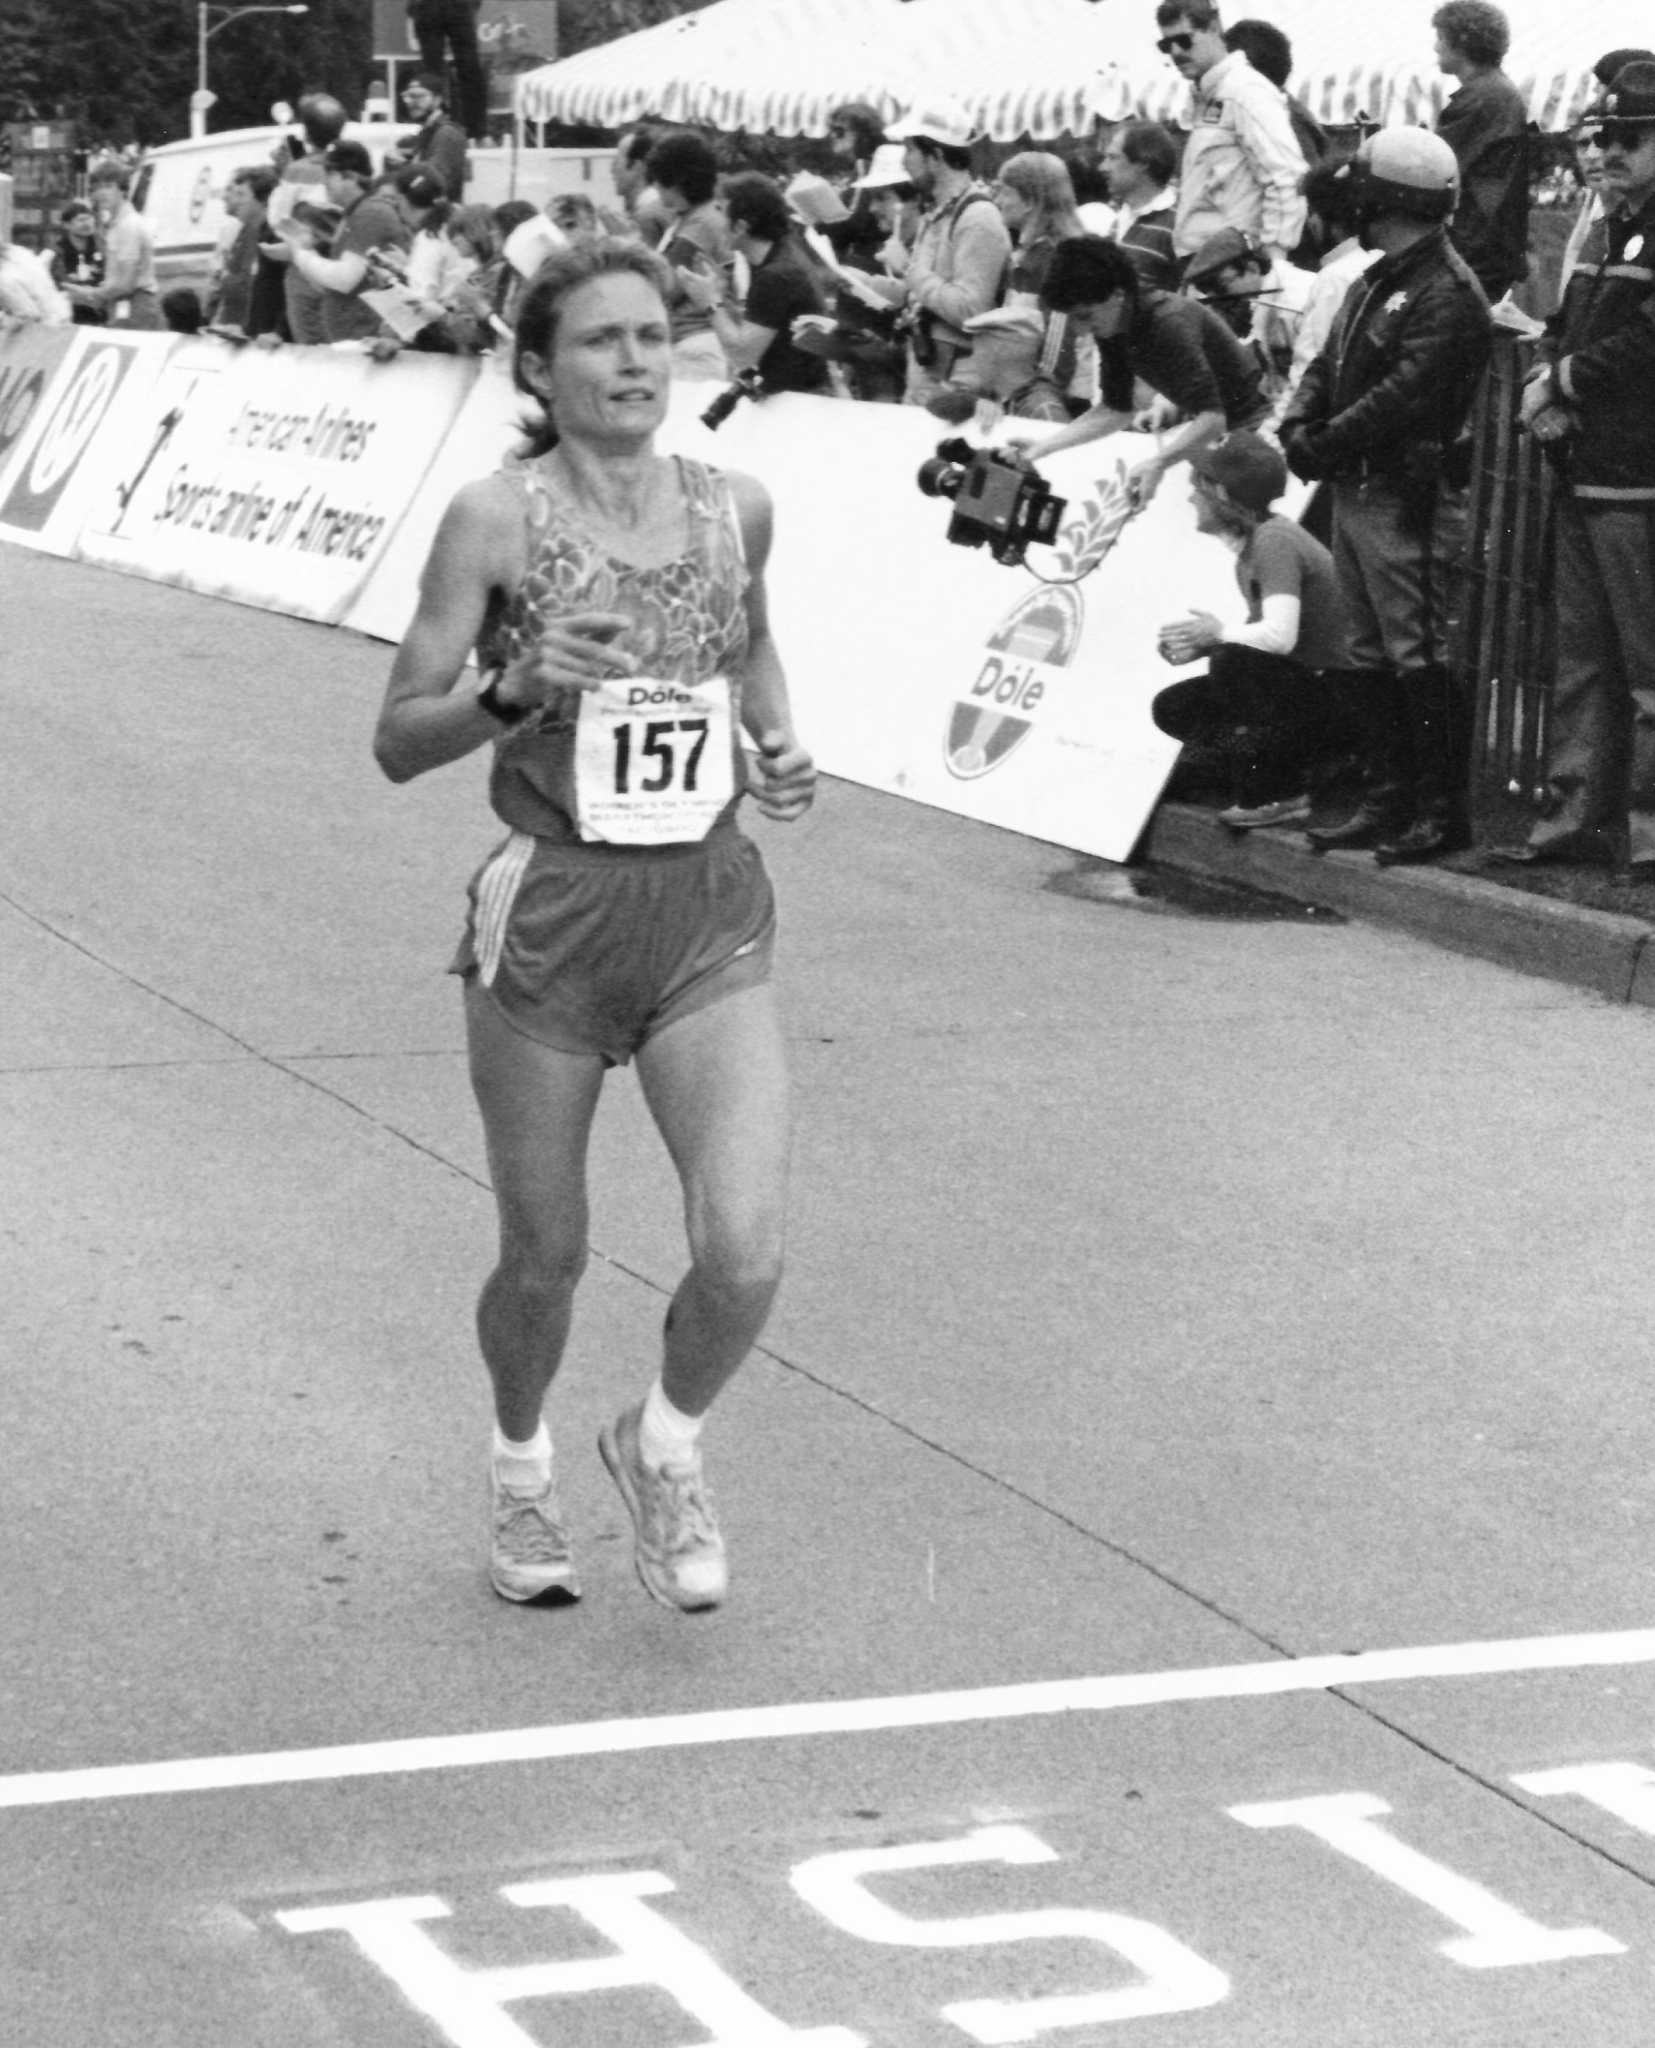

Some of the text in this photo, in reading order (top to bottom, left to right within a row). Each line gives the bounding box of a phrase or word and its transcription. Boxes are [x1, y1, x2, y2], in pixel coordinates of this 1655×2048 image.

[152, 463, 223, 533] Sports
[264, 484, 312, 545] of
[289, 492, 387, 562] America
[628, 684, 692, 706] Dole
[970, 655, 1045, 711] Dole
[614, 718, 709, 794] 157
